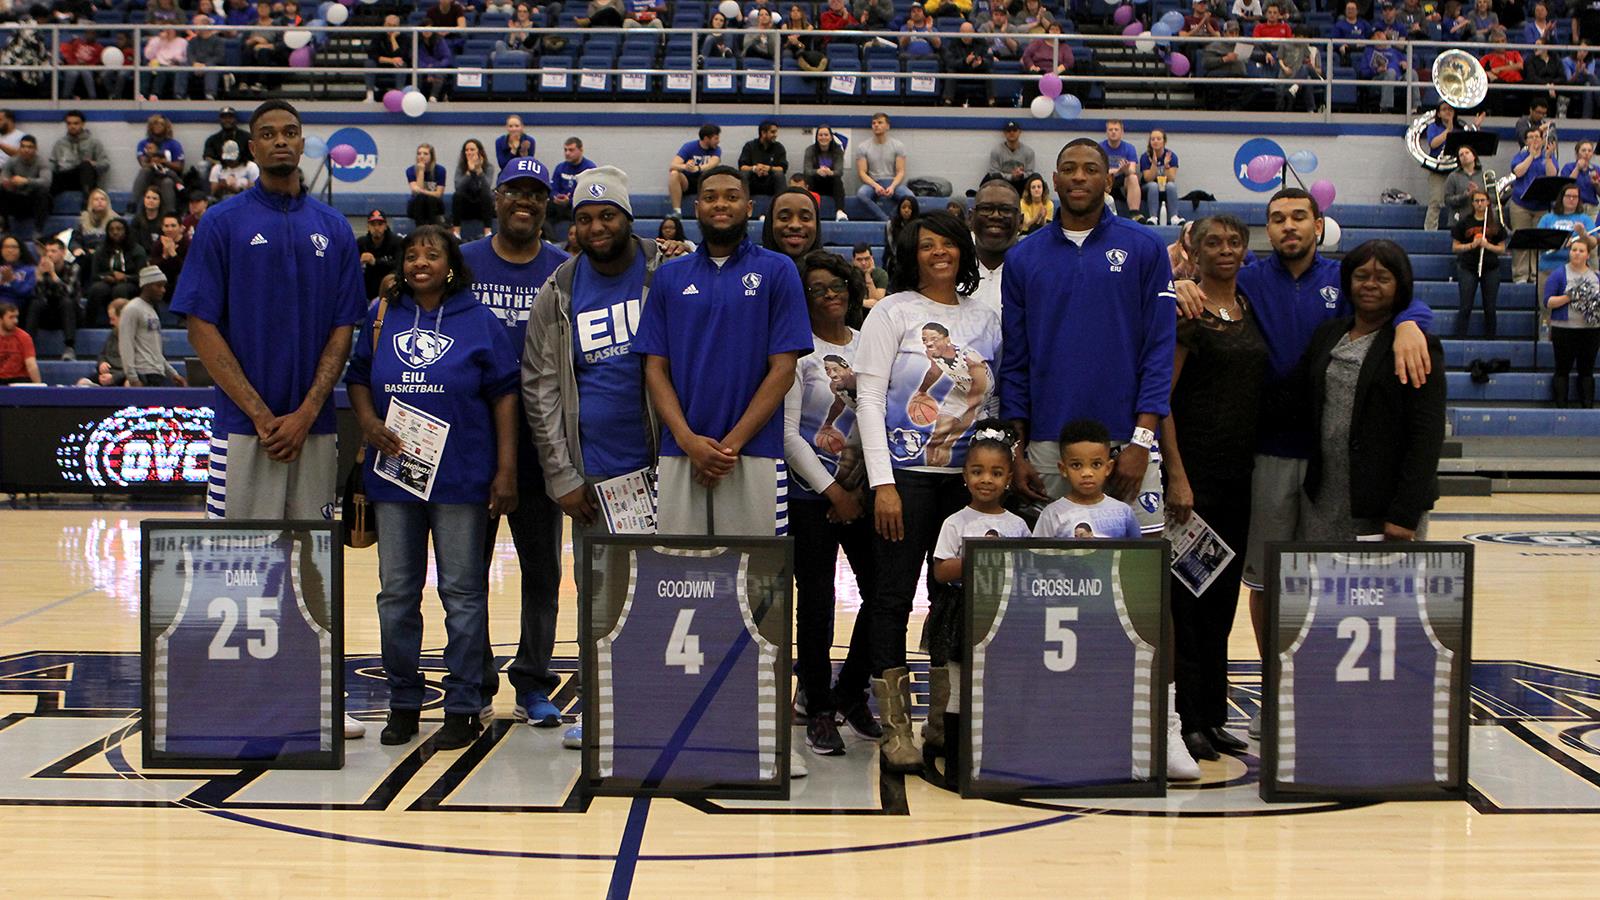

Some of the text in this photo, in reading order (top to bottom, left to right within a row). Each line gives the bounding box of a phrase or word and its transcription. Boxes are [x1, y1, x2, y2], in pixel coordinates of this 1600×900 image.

[518, 160, 541, 174] EIU
[471, 283, 511, 292] EASTERN
[585, 342, 632, 363] BASKE
[402, 371, 425, 383] EIU
[384, 384, 445, 393] BASKETBALL
[225, 570, 258, 587] DAMA
[1031, 578, 1103, 597] CROSSLAND
[657, 580, 716, 598] GOODWIN
[1351, 588, 1385, 606] PRICE
[208, 597, 280, 660] 25
[665, 608, 705, 675] 4
[1043, 607, 1080, 673] 5
[1335, 616, 1397, 682] 21
